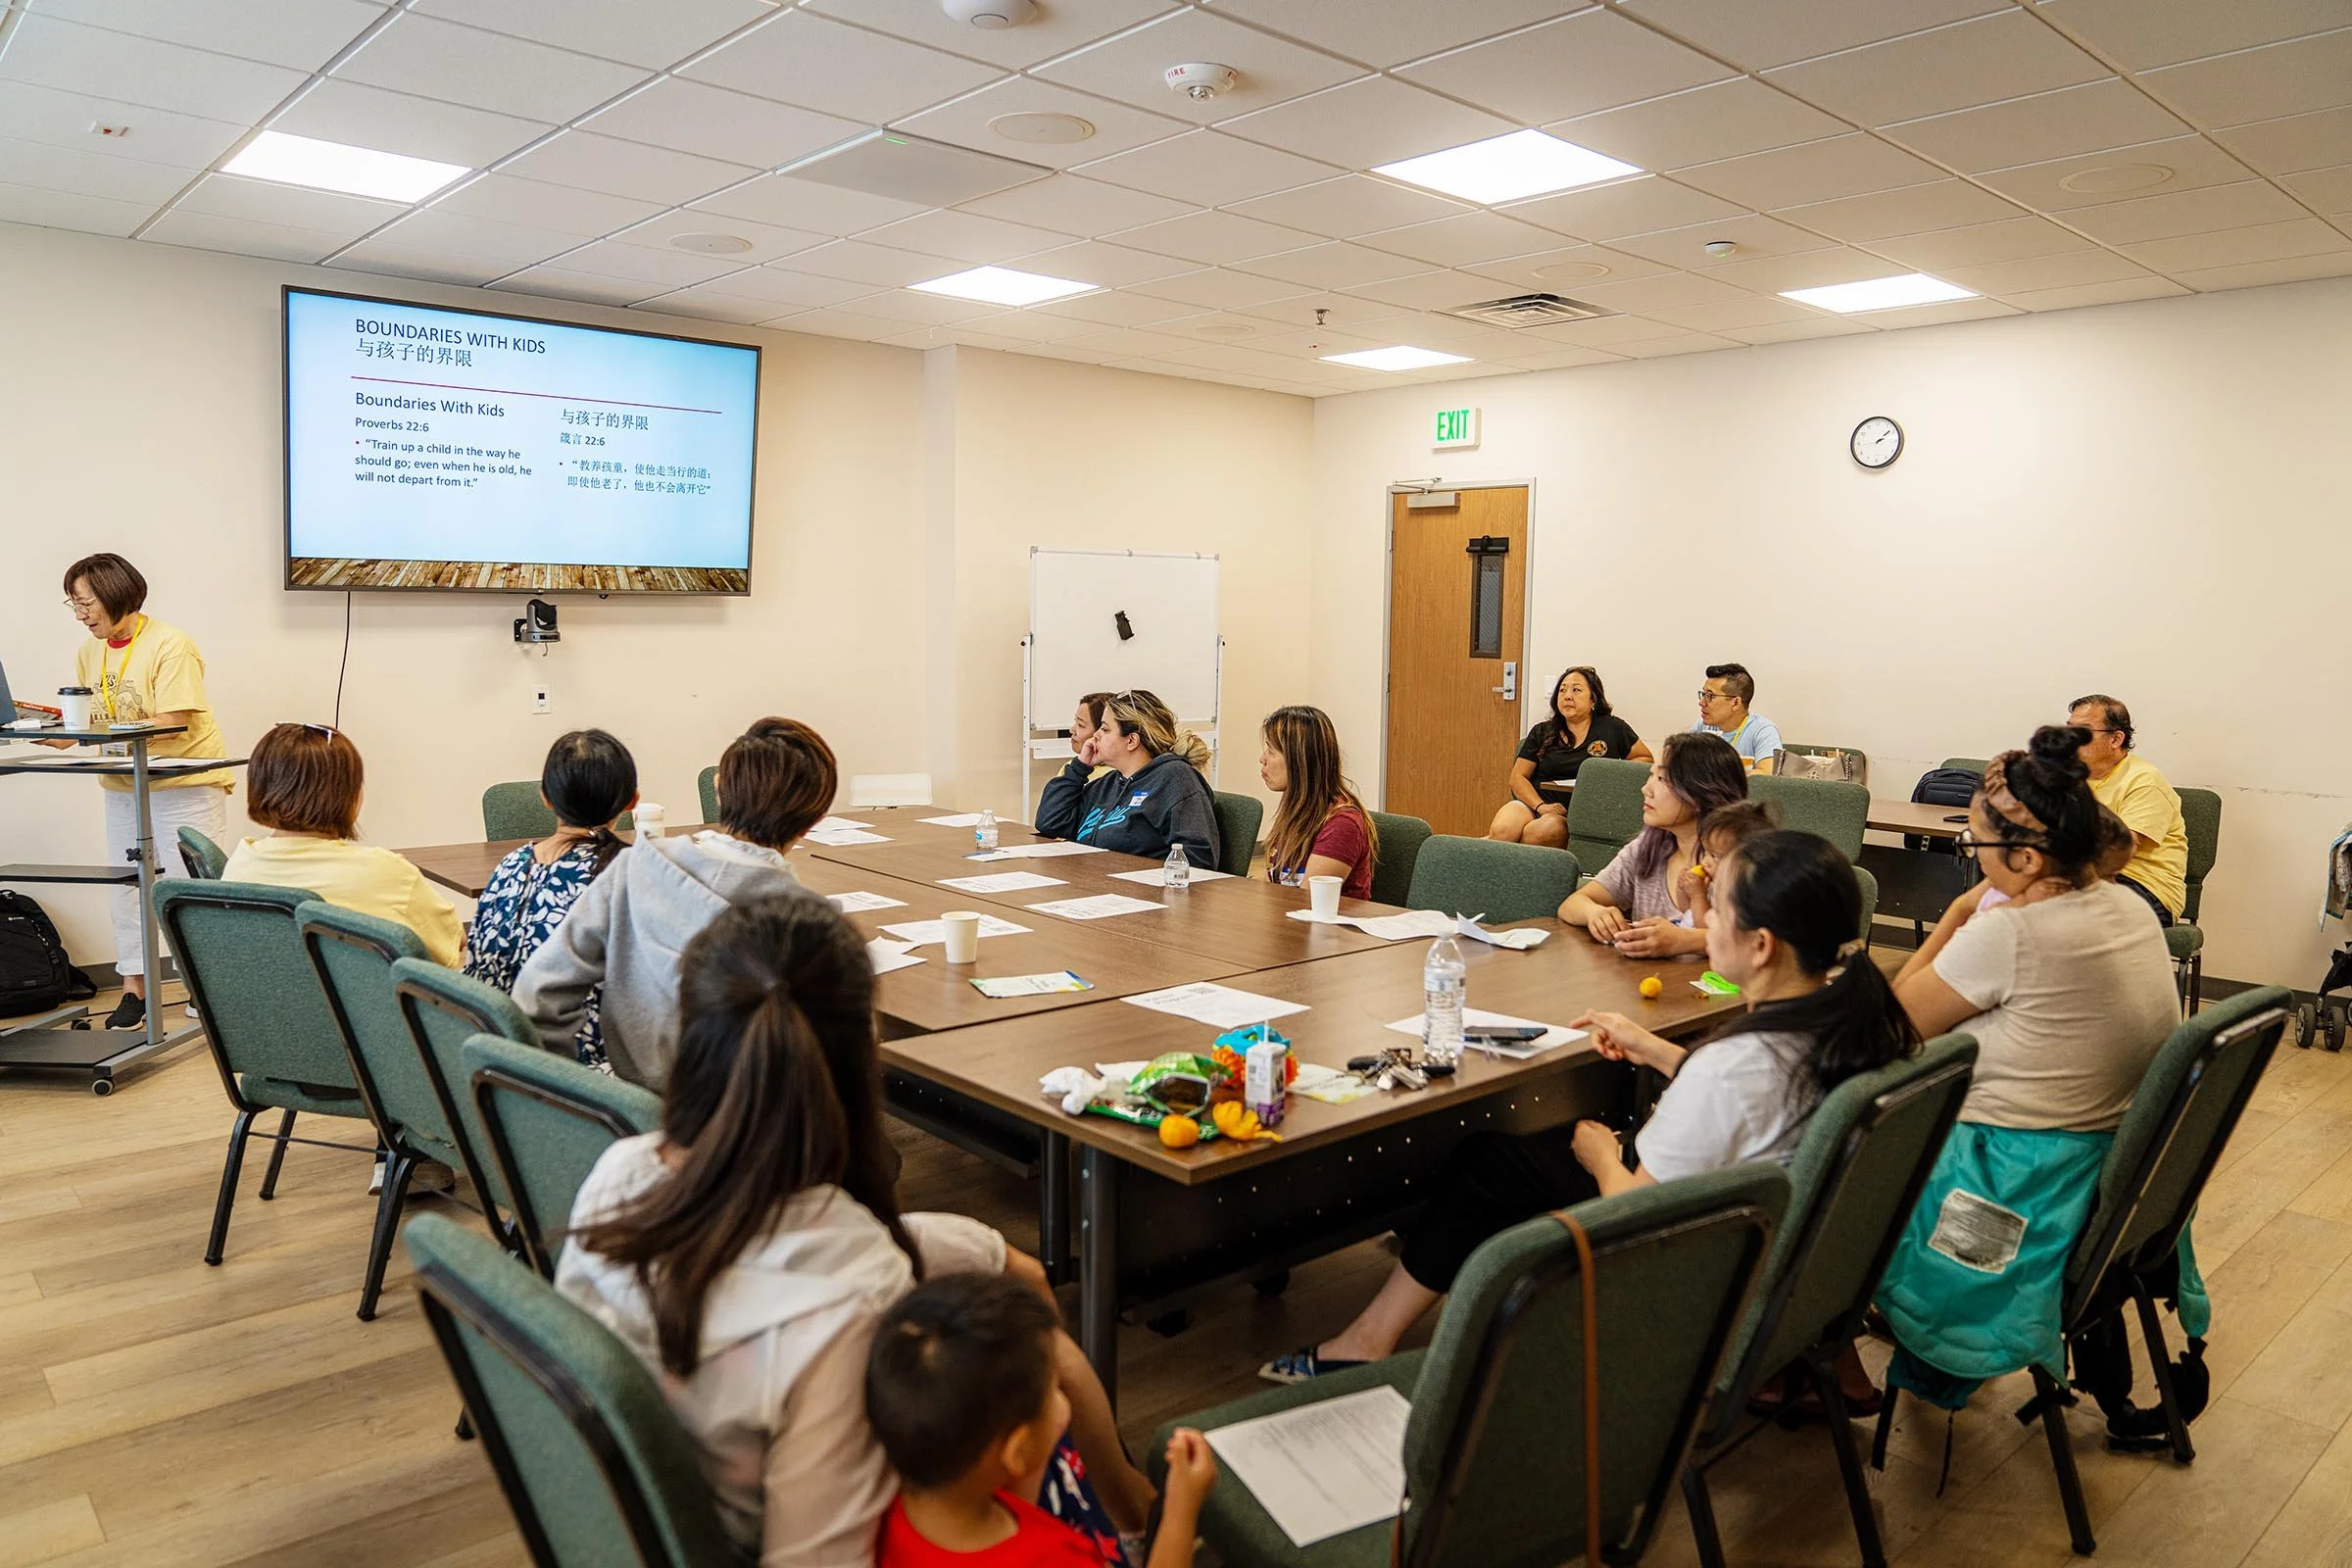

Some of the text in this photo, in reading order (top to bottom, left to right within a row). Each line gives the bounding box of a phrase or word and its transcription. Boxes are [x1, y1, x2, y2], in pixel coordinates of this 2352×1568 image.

[1167, 67, 1186, 78] FIRE
[356, 319, 546, 354] BOUNDARIES WITH KIDS
[356, 337, 472, 368] 与孩子的界限
[356, 392, 505, 416] Boundaries With Kids
[355, 417, 429, 432] Proverbs 22:6
[561, 408, 649, 430] 与孩子的界限
[1437, 409, 1469, 441] EXIT
[366, 438, 398, 451] “Train
[401, 442, 416, 454] up
[426, 444, 452, 455] child
[454, 446, 464, 456] in
[466, 447, 484, 457] the
[485, 450, 506, 460] way
[508, 450, 521, 459] he
[585, 435, 606, 447] 22:6
[355, 455, 532, 476] should go; even when he is old, he
[355, 471, 374, 482] will
[377, 473, 395, 483] not
[398, 473, 433, 486] depart
[436, 476, 462, 486] from
